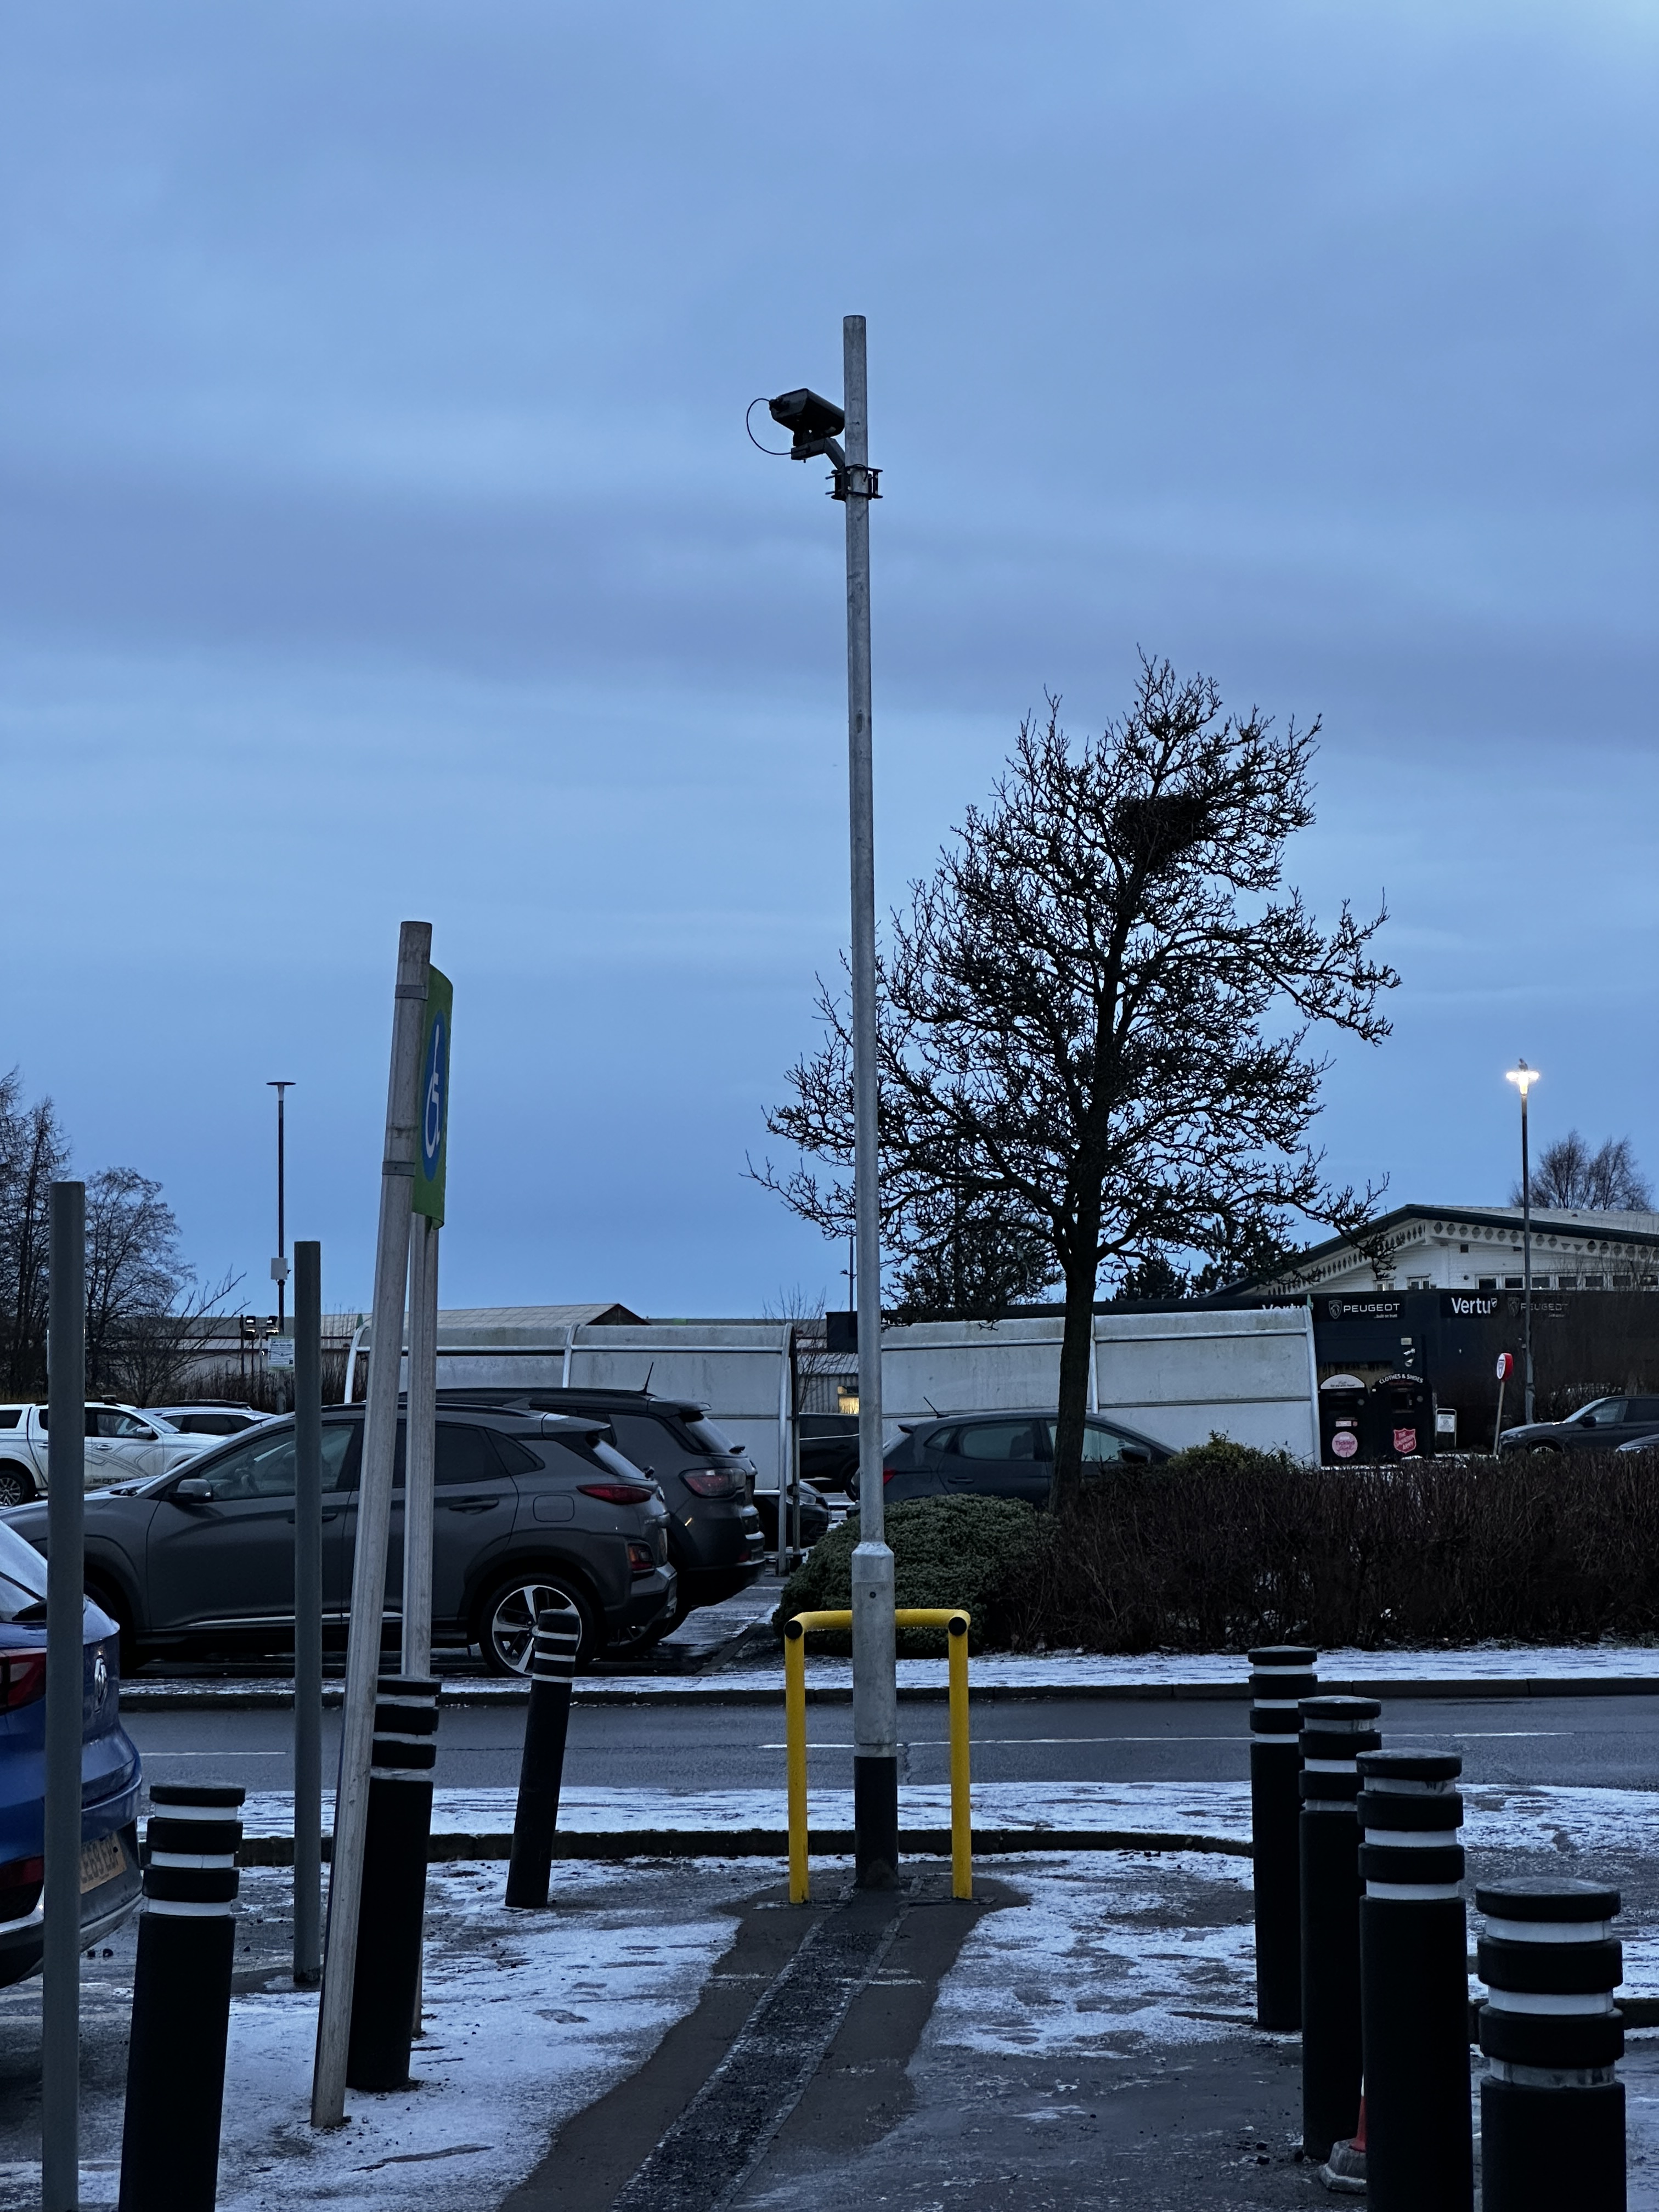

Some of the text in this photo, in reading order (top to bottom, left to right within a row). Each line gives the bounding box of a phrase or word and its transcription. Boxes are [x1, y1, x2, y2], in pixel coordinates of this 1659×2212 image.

[1344, 1303, 1400, 1313] PEUGEOT
[1451, 1297, 1491, 1314] Vertu
[1379, 1373, 1401, 1384] CLOTHES
[1406, 1374, 1424, 1383] SHOES
